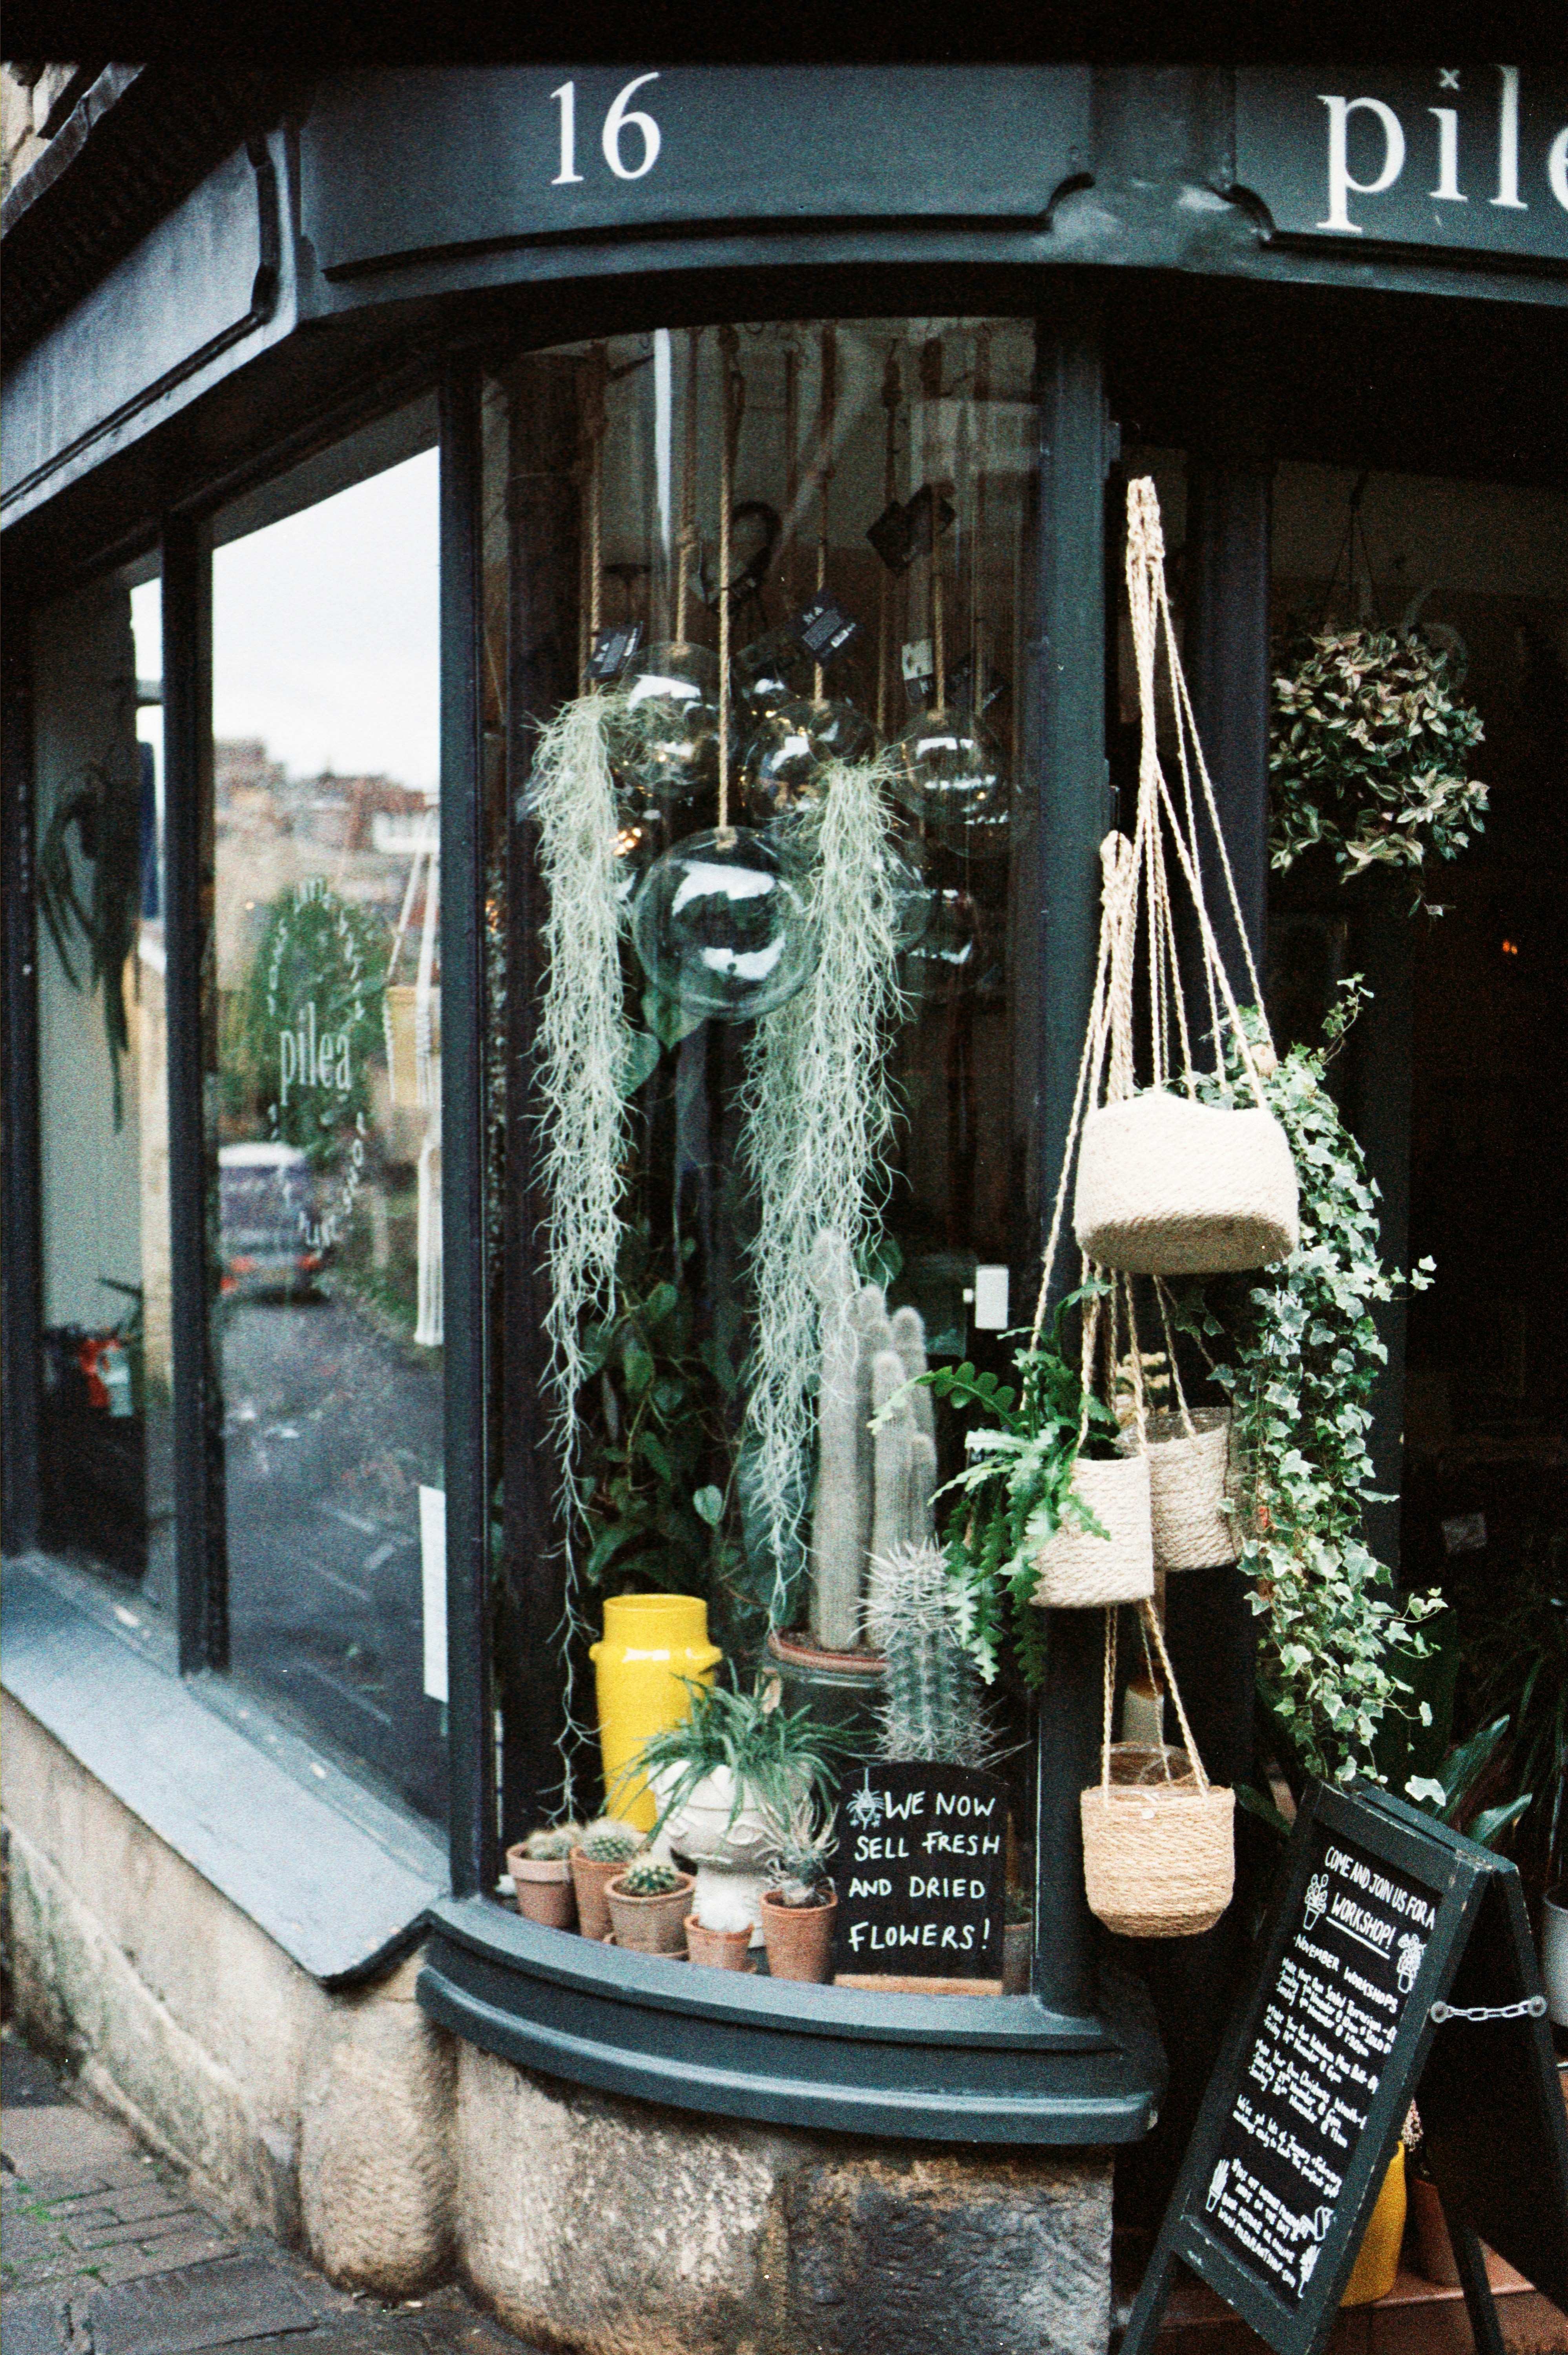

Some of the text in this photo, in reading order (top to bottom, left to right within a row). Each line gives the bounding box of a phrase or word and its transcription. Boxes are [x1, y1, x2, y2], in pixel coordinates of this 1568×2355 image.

[551, 73, 661, 184] 16
[280, 1002, 352, 1106] pilea
[885, 1791, 995, 1819] WE NOW
[854, 1831, 999, 1861] SELL FRESH
[849, 1876, 985, 1899] AND DRIED
[1324, 1846, 1435, 1930] COME AND JOIN US FOR A
[849, 1919, 989, 1951] FLOWERS!
[1331, 1892, 1396, 1950] WORKSHOP!
[1294, 1933, 1398, 2014] NOVEMBER WORKSHOPS
